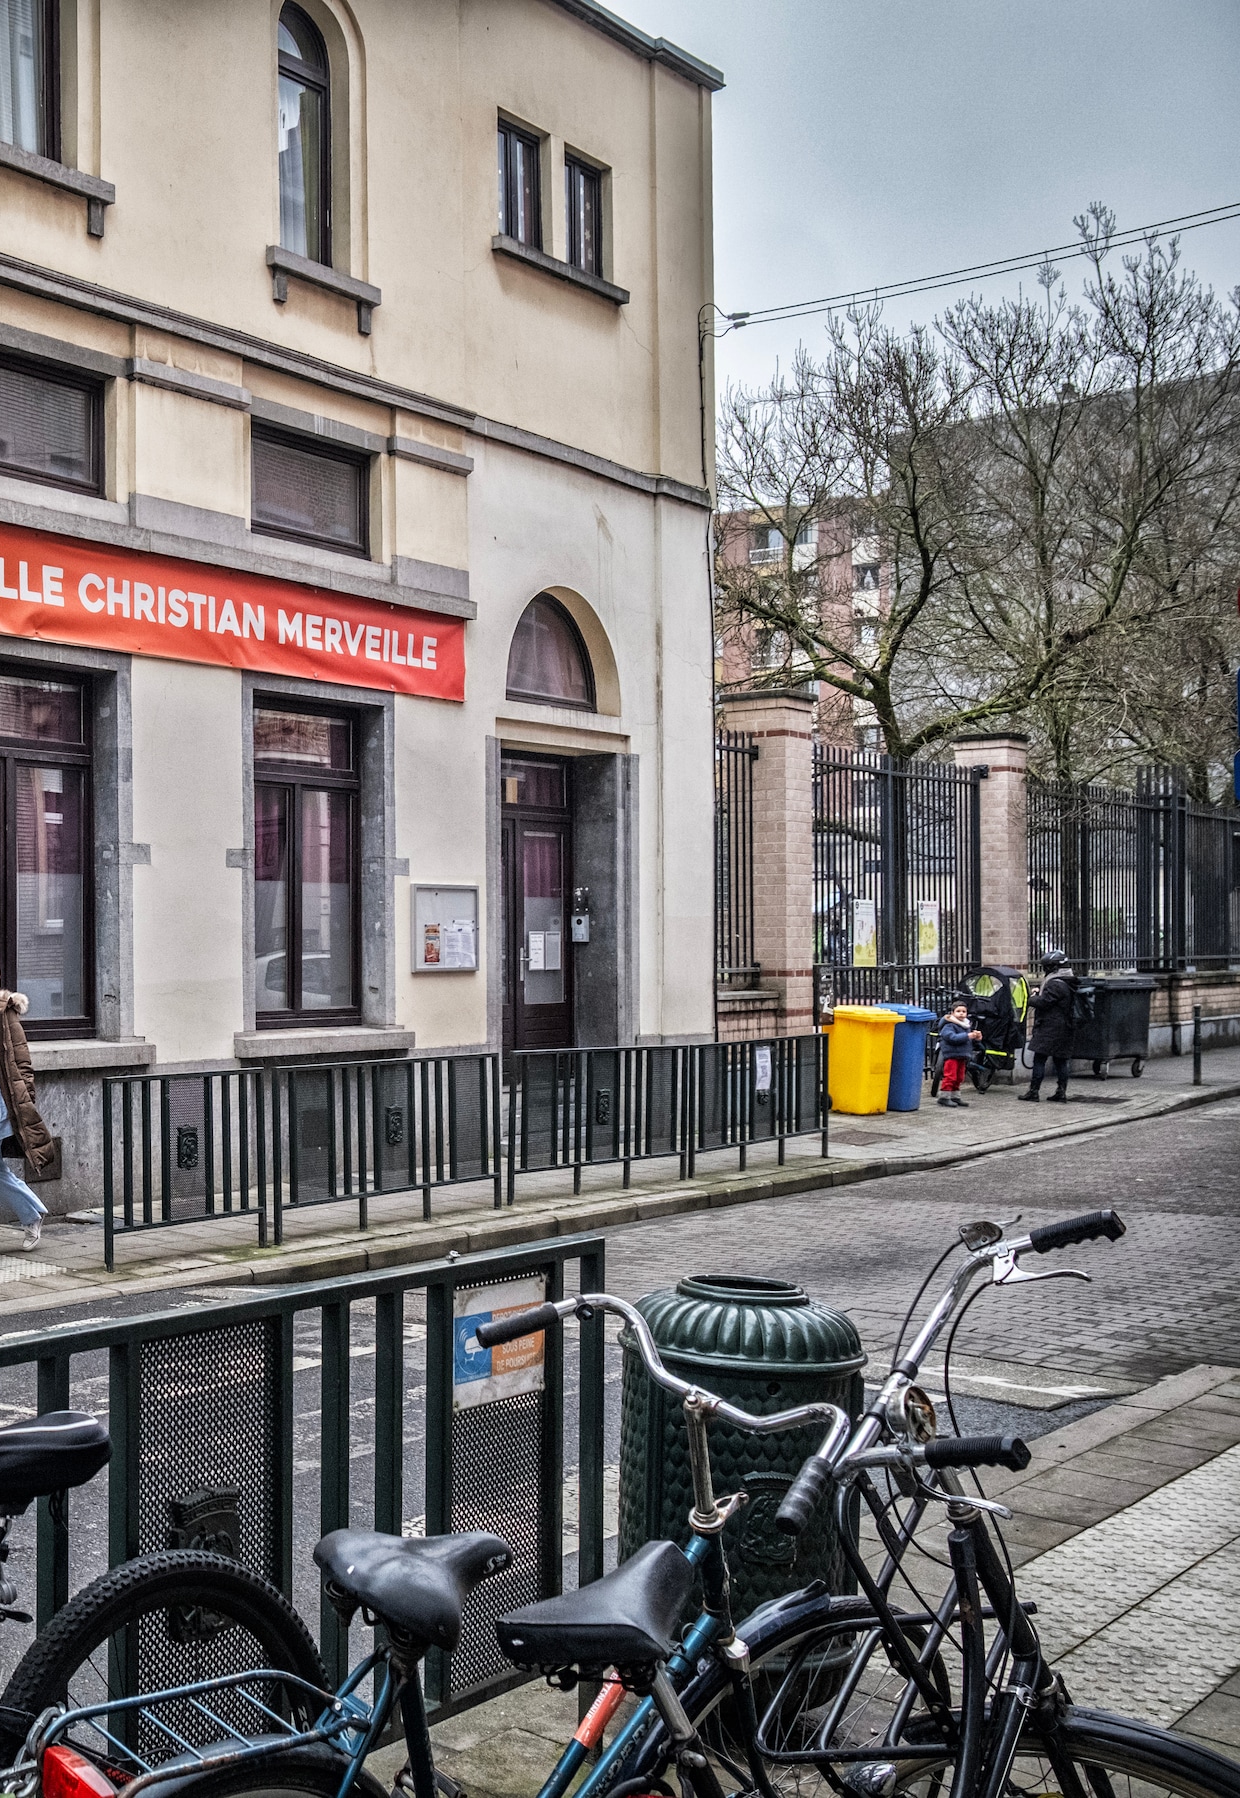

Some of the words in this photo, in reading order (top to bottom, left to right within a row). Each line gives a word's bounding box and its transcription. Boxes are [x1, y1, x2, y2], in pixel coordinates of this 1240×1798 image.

[77, 572, 266, 642] CHRISTIAN
[277, 608, 438, 671] MERVEILLE
[502, 1340, 518, 1354] SOUS
[518, 1336, 535, 1351] PEINE
[496, 1359, 506, 1371] DE
